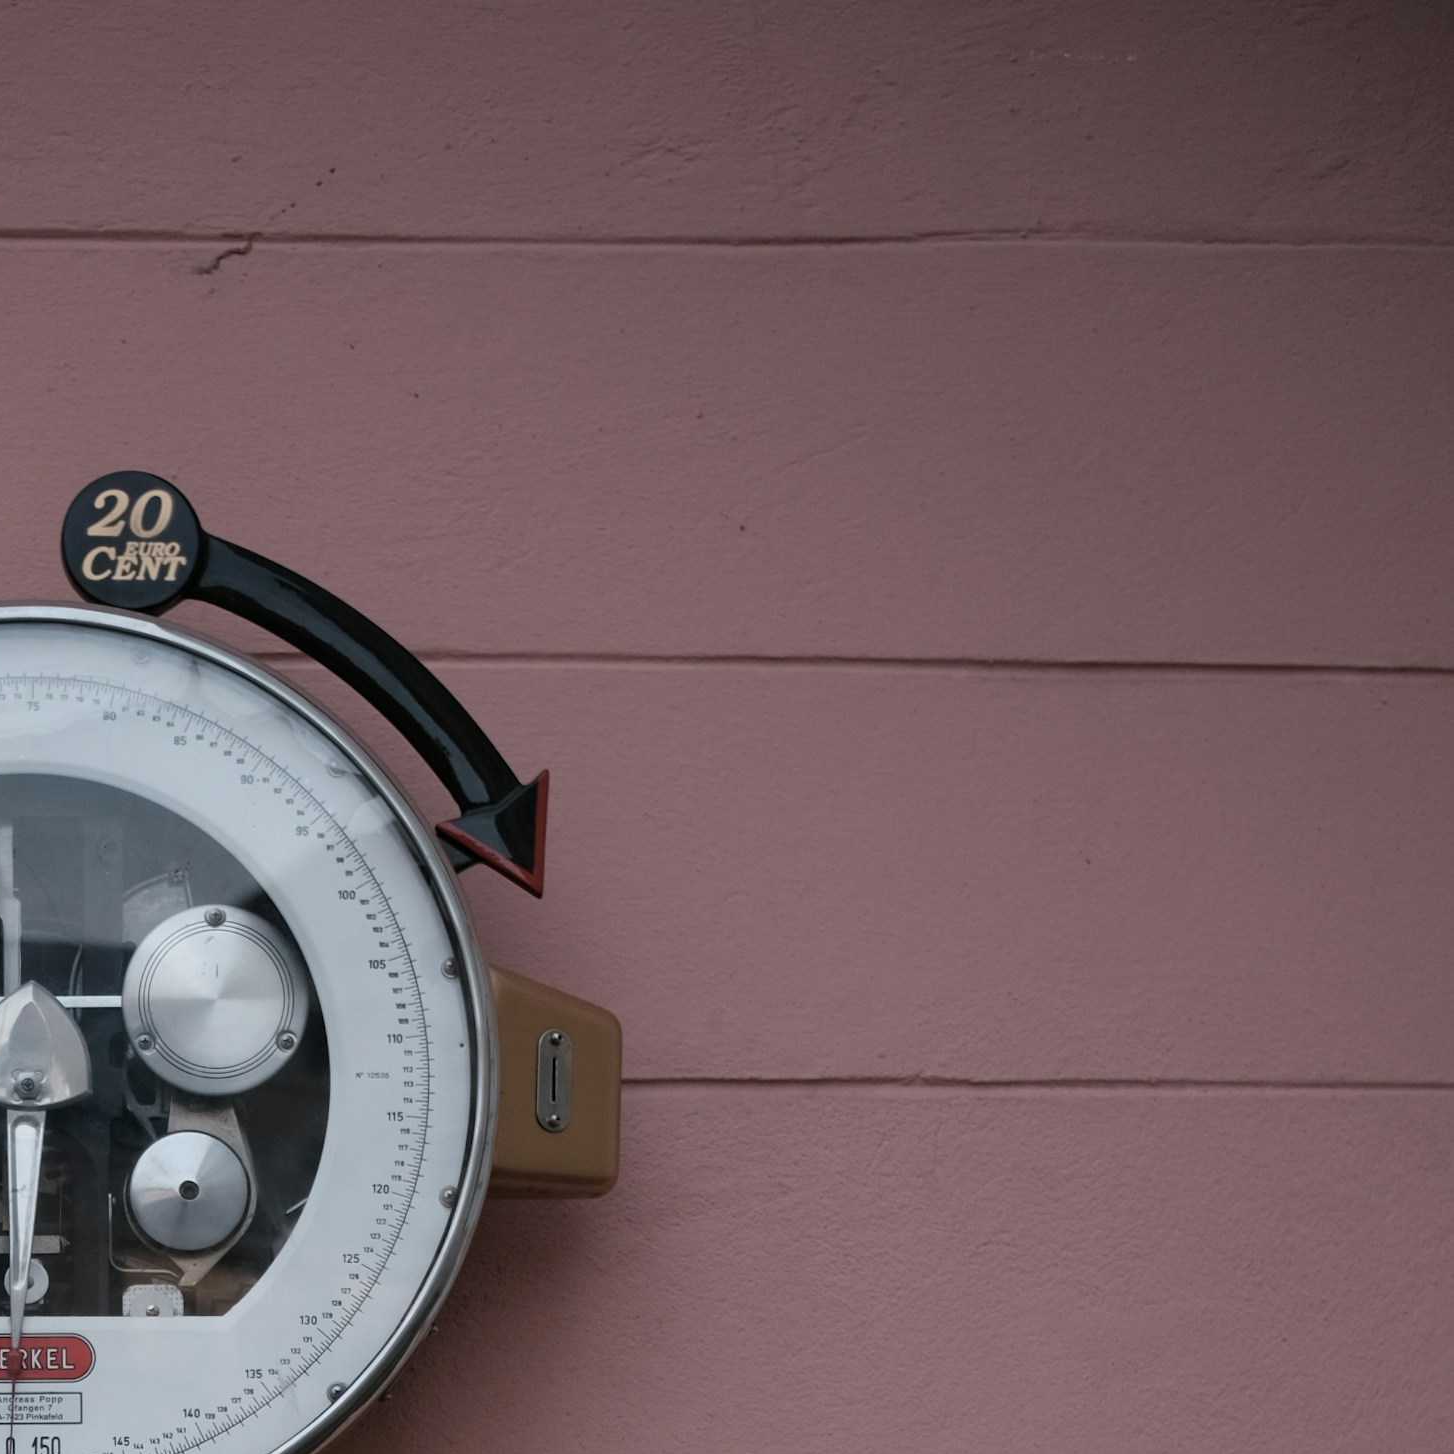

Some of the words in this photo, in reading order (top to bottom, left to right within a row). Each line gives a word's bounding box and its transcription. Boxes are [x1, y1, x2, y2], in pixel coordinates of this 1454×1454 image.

[86, 488, 174, 539] 20
[123, 541, 181, 557] EURO
[81, 546, 187, 581] CENT
[27, 701, 40, 711] 75
[103, 711, 116, 721] 80
[174, 736, 187, 746] 85
[241, 775, 254, 785] 90
[296, 826, 309, 836] 95
[338, 890, 356, 900] 100
[369, 960, 386, 969] 105
[387, 1034, 403, 1043] 110
[387, 1112, 403, 1121] 115
[372, 1184, 389, 1194] 120
[343, 1254, 359, 1263] 125
[300, 1315, 317, 1325] 130
[245, 1369, 262, 1379] 135
[39, 1396, 63, 1405] Popp
[183, 1409, 200, 1418] 140
[113, 1437, 130, 1446] 145
